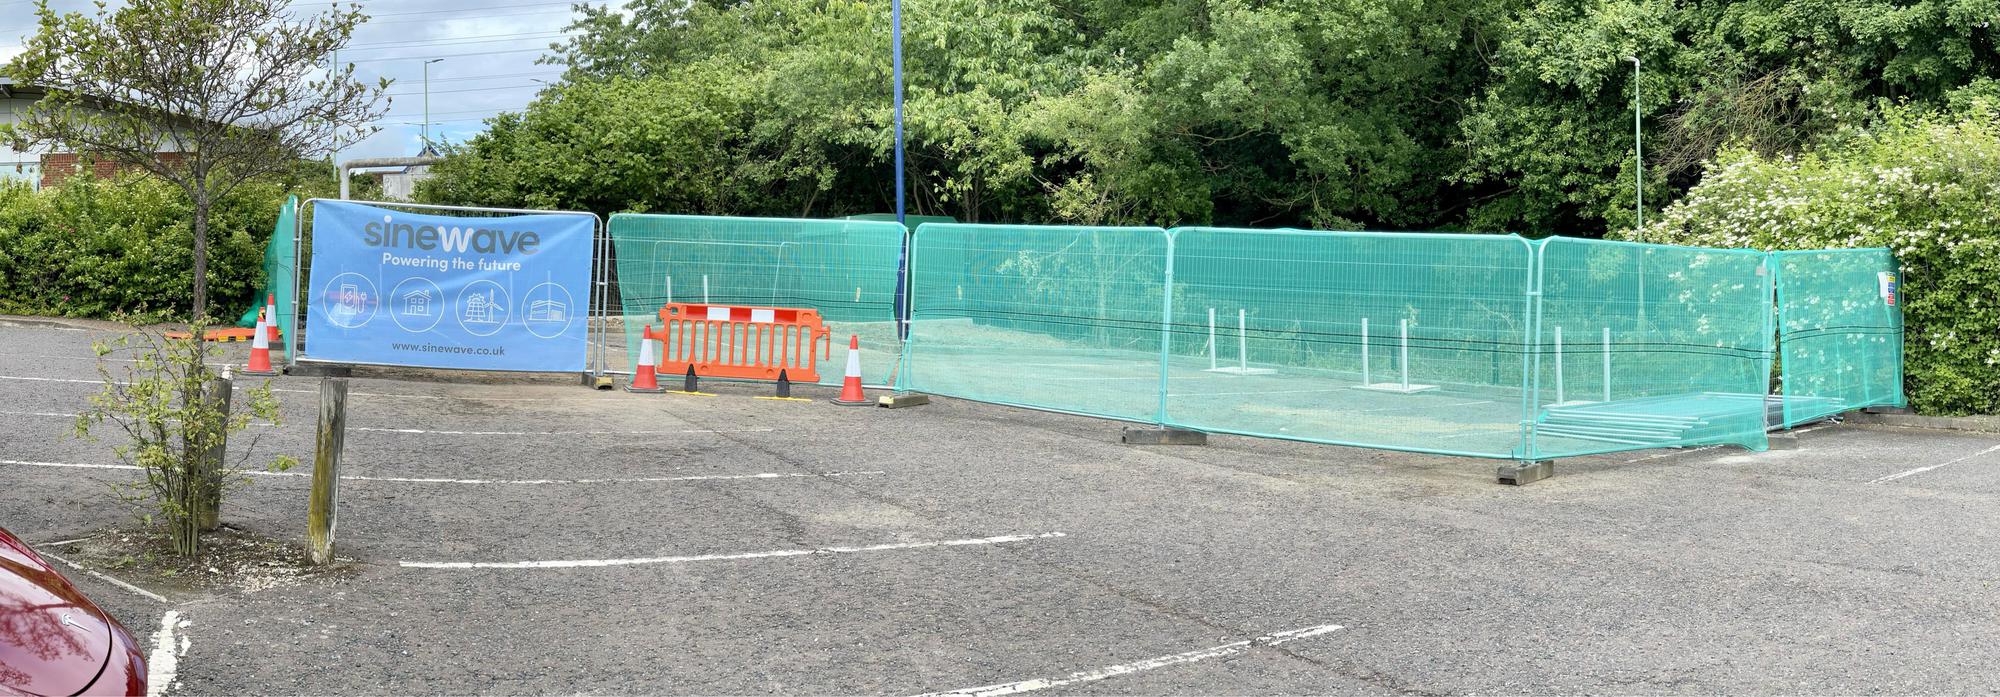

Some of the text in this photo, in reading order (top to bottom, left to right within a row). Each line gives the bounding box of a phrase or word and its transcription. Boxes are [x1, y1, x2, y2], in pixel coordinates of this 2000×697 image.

[364, 215, 540, 255] sinewave
[382, 252, 521, 272] Powering the future
[392, 342, 505, 356] www.sinewave.co.uk
